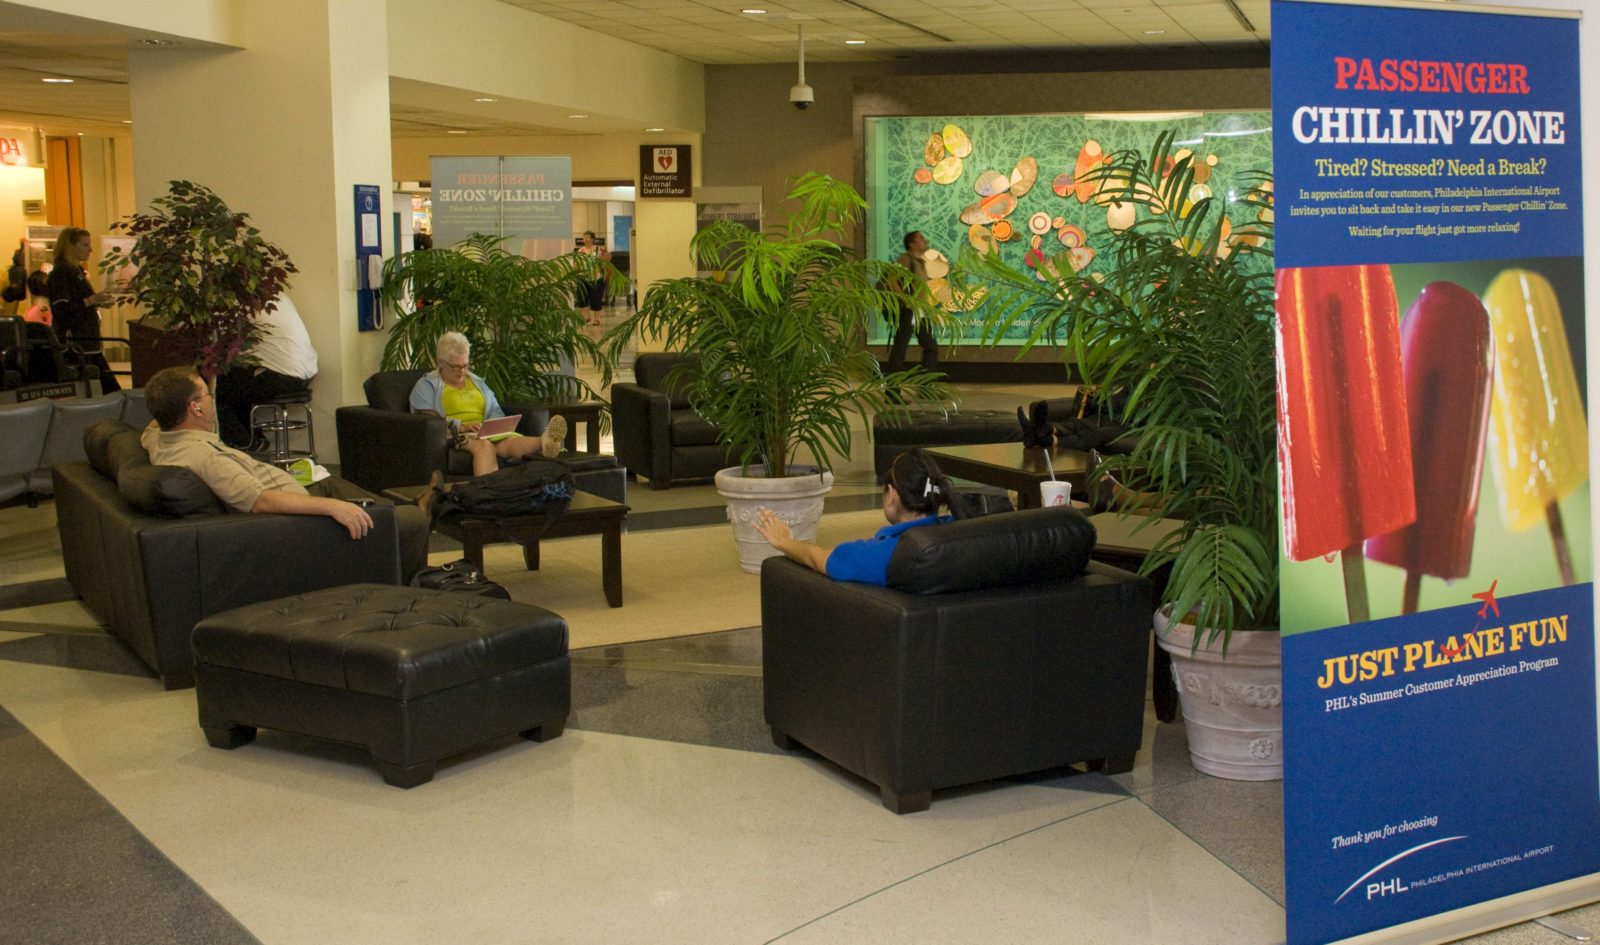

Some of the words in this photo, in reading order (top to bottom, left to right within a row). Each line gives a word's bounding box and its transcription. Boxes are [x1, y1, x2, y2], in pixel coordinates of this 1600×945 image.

[1335, 57, 1530, 95] PASSENGER
[1292, 106, 1463, 144] CHILLIN'
[1470, 110, 1565, 144] ZONE
[1315, 159, 1368, 176] Tired?
[1371, 159, 1445, 176] Stressed?
[1447, 159, 1485, 176] Need
[1487, 164, 1496, 175] a
[1498, 158, 1546, 175] Break?
[1290, 205, 1320, 216] invites
[1320, 206, 1336, 217] you
[1338, 206, 1347, 214] to
[1347, 204, 1359, 214] sit
[1359, 204, 1379, 214] back
[1381, 203, 1396, 214] and
[1397, 203, 1414, 213] take
[1415, 203, 1422, 213] it
[1423, 205, 1440, 214] easy
[1441, 203, 1449, 213] in
[1482, 202, 1520, 213] Passenger
[1548, 201, 1568, 210] Zone.
[1299, 189, 1309, 199] In
[1310, 188, 1364, 201] appreciation
[1365, 188, 1375, 198] of
[1375, 190, 1388, 198] our
[1390, 188, 1434, 199] customers,
[1434, 187, 1482, 199] Philadelphia
[1484, 186, 1533, 196] International
[1533, 186, 1560, 196] Airport
[1348, 226, 1382, 237] Waiting
[1383, 225, 1395, 236] for
[1395, 228, 1415, 237] your
[1415, 224, 1436, 236] flight
[1437, 224, 1453, 236] just
[1453, 225, 1466, 235] got
[1467, 225, 1487, 233] more
[1488, 221, 1520, 233] relaxing!
[1317, 647, 1399, 689] JUST
[1403, 626, 1504, 672] PLANE
[1509, 615, 1568, 651] FUN
[1359, 688, 1403, 705] Summer
[1405, 676, 1454, 696] Customer
[1455, 664, 1518, 687] Appreciation
[1518, 656, 1559, 673] Program
[1331, 831, 1363, 850] Thank
[1364, 830, 1382, 843] you
[1382, 823, 1398, 840] for
[1398, 815, 1439, 833] choosing
[1366, 877, 1409, 900] PHL
[1410, 869, 1464, 889] PHILADELPHIA
[1465, 853, 1522, 875] INTERNATIONAL
[1523, 845, 1554, 859] AIRPORT
